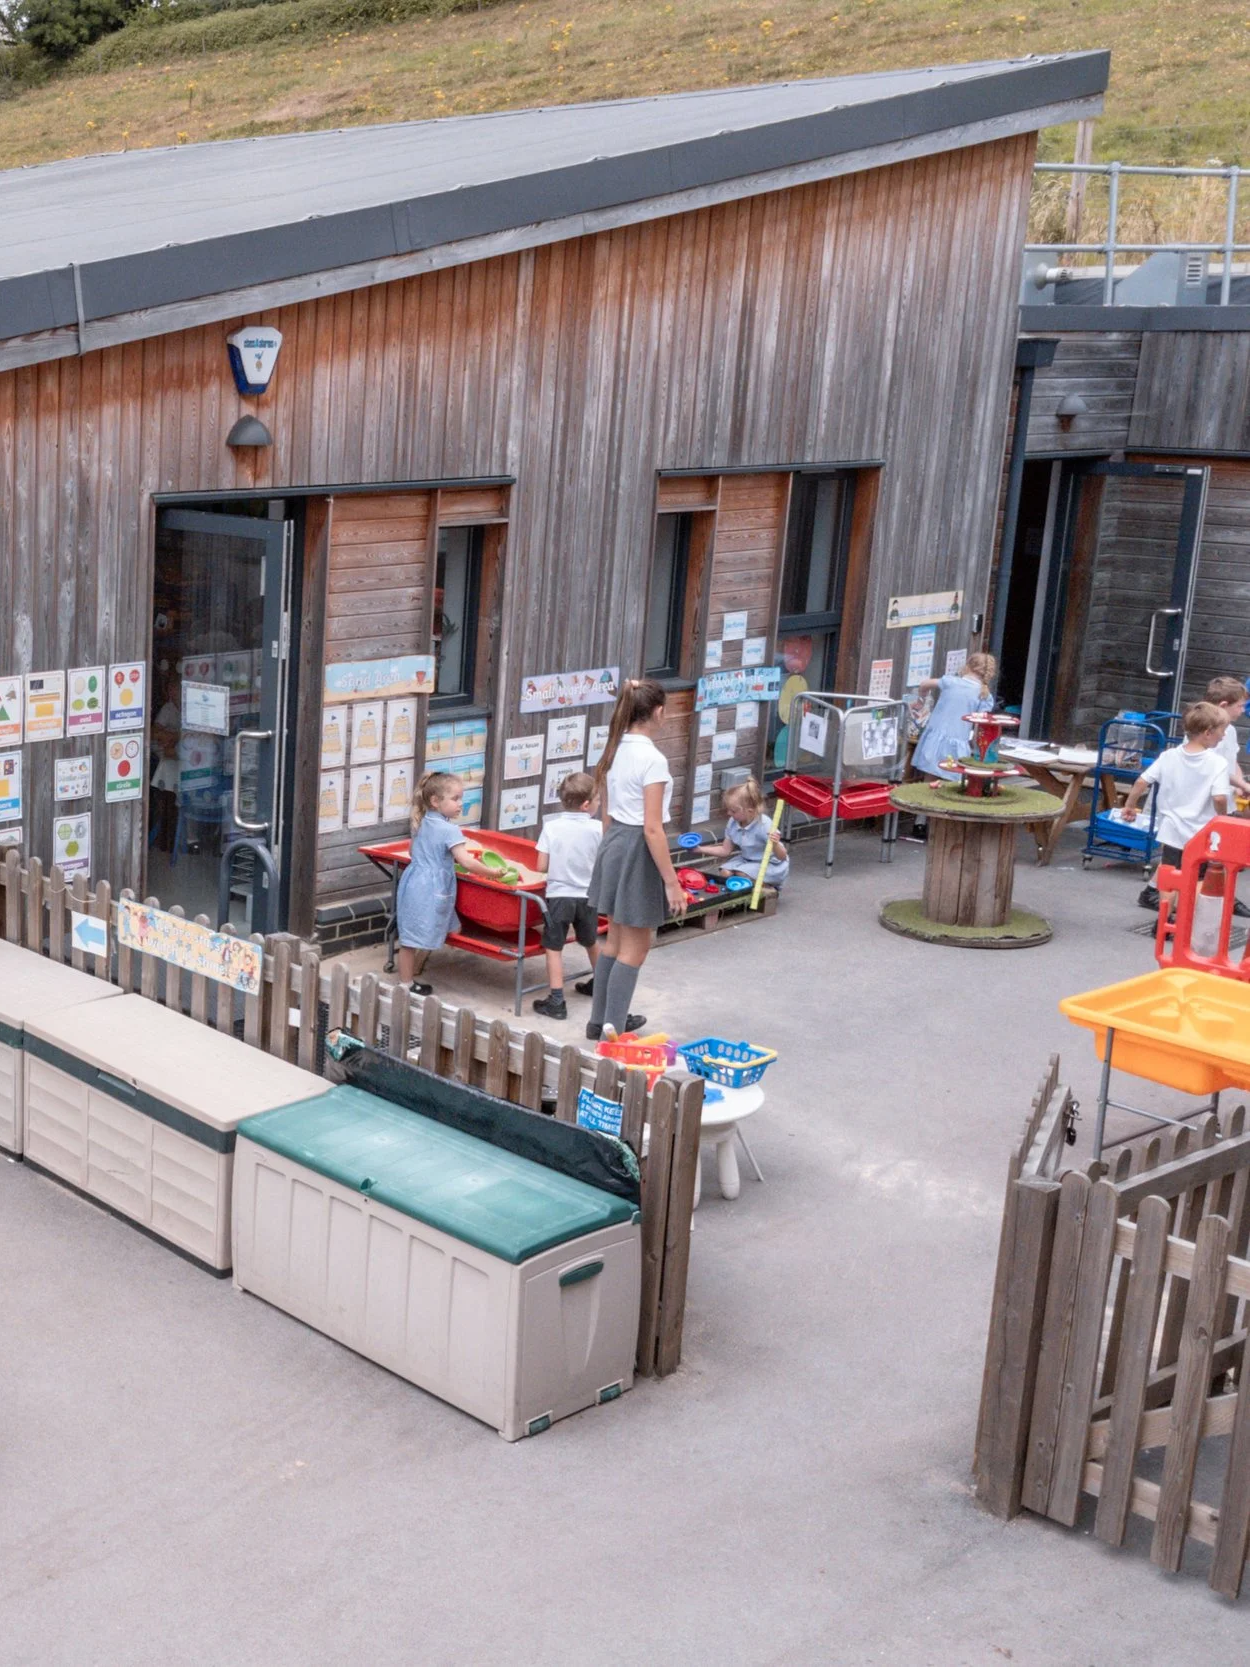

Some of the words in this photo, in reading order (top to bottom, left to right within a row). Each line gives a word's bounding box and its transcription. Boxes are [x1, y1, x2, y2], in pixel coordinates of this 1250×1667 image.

[341, 672, 371, 689] Sand
[374, 670, 400, 686] Area
[525, 685, 555, 701] Small
[590, 679, 615, 693] Area
